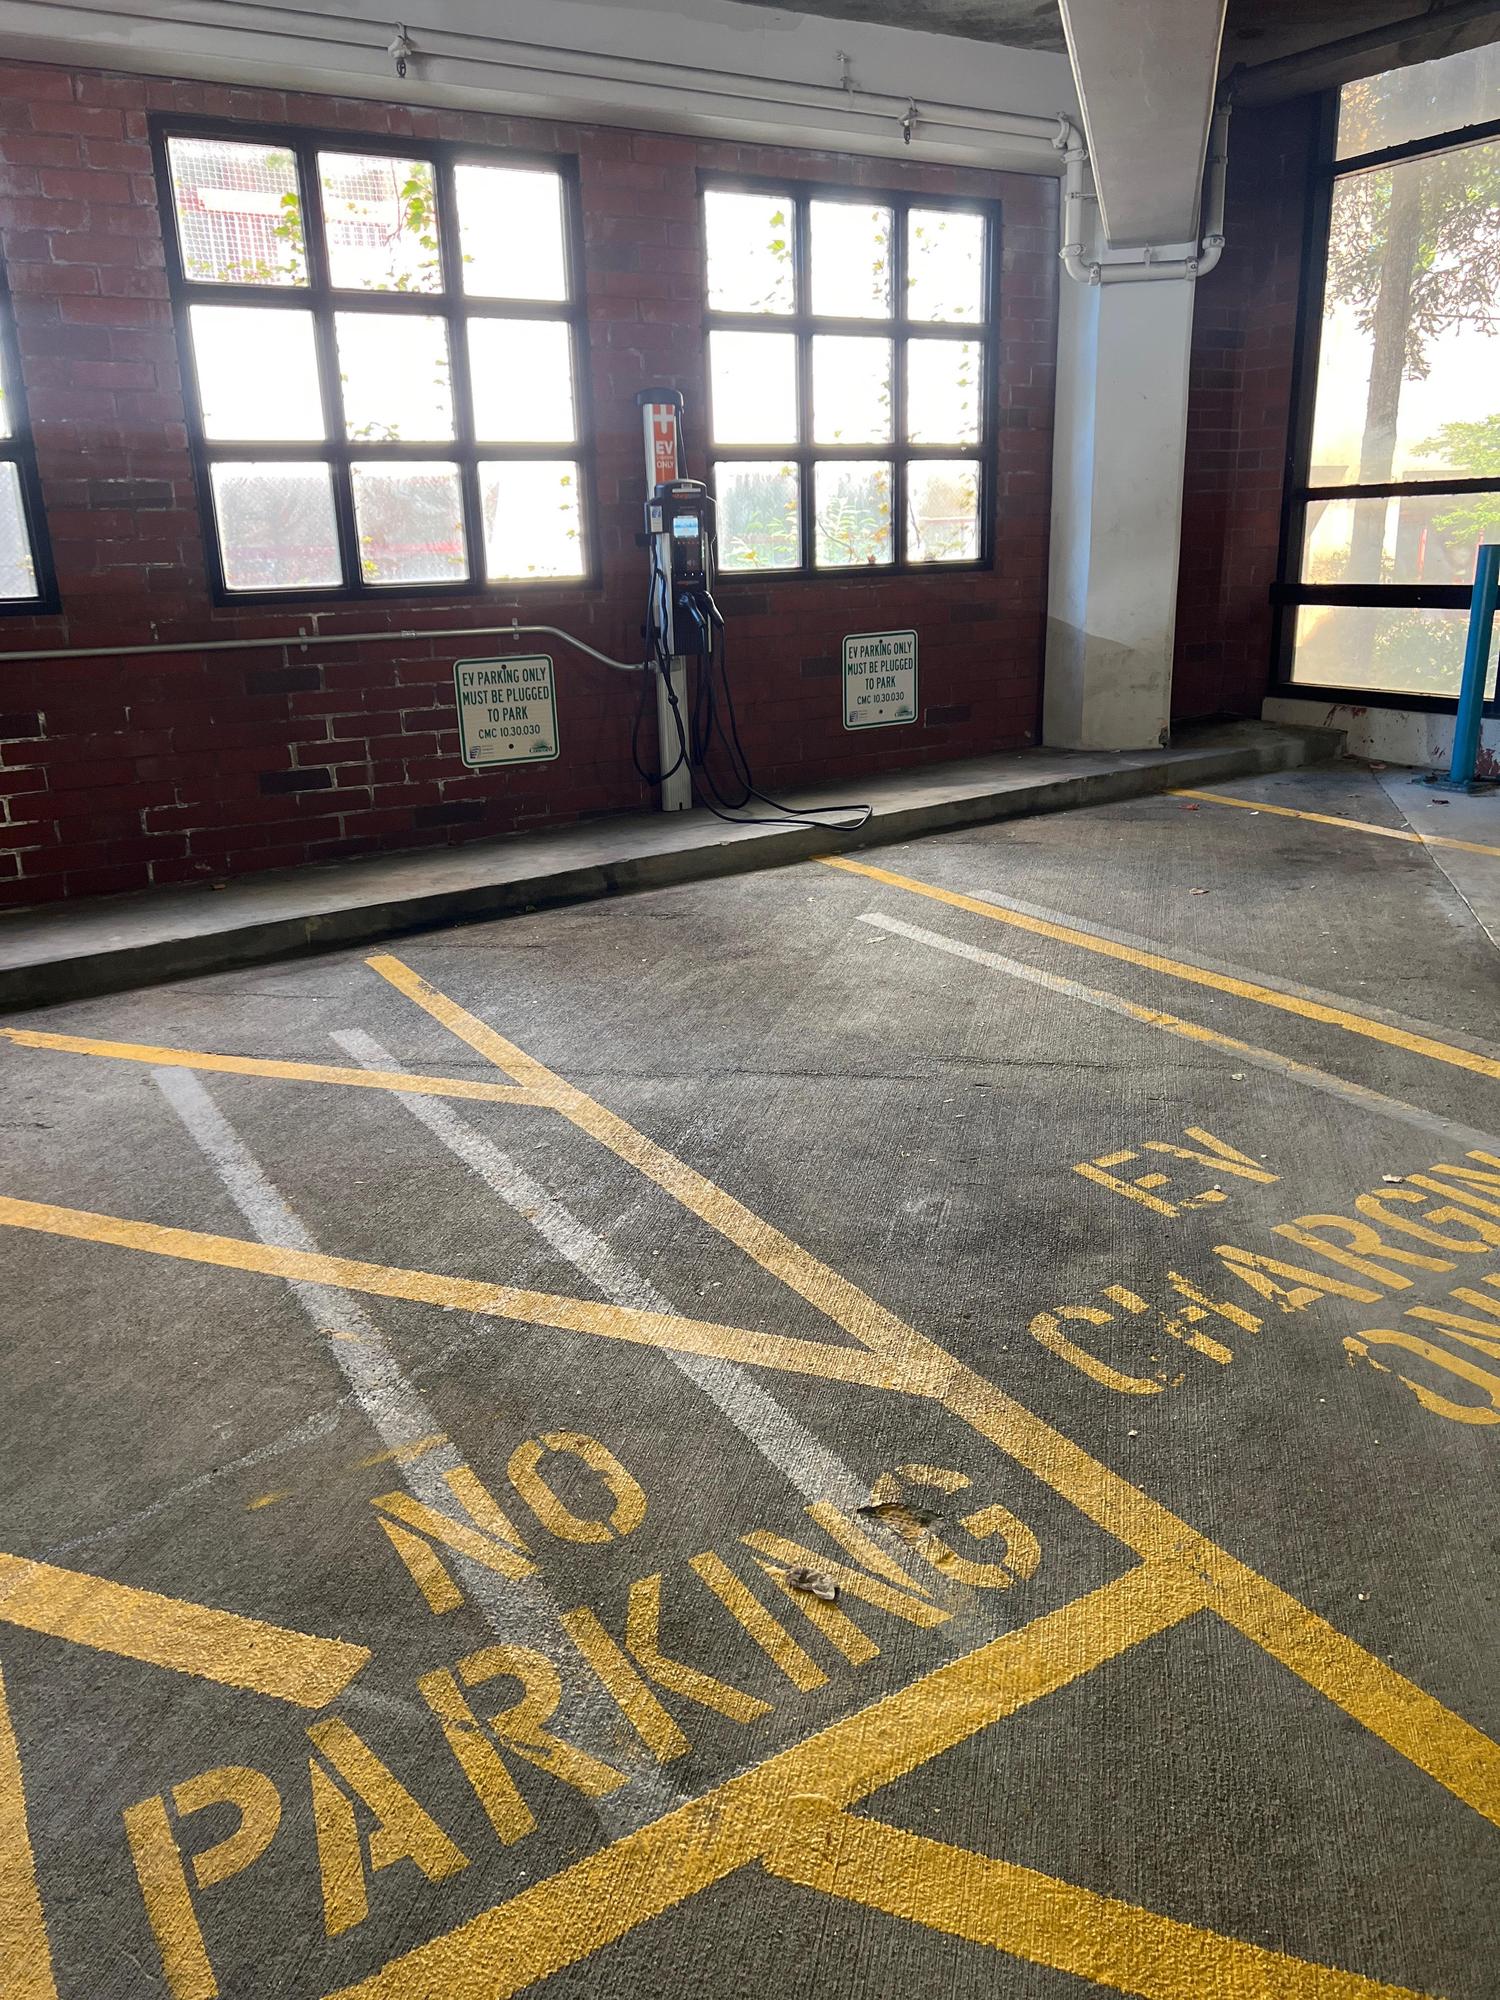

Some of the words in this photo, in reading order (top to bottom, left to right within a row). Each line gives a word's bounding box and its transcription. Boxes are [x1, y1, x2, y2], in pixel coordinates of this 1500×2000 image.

[655, 440, 673, 455] EV
[656, 460, 674, 469] ONLY
[848, 646, 858, 659] EV
[860, 642, 892, 658] PARKING
[893, 641, 912, 655] ONLY
[847, 662, 867, 676] MUST
[869, 660, 878, 673] BE
[880, 657, 913, 672] PLUGGED
[462, 672, 475, 686] EV
[477, 669, 520, 686] PARKING
[522, 667, 546, 682] ONLY
[865, 678, 874, 690] TO
[876, 675, 896, 689] PARK
[462, 690, 488, 706] MUST
[491, 689, 504, 704] BE
[506, 686, 550, 702] PLUGGED
[857, 695, 871, 705] CMC
[873, 691, 904, 703] 10.30.030
[487, 708, 500, 722] TO
[502, 706, 528, 721] PARK
[478, 728, 497, 739] CMC
[500, 724, 540, 737] 10.30.030
[1072, 1126, 1282, 1218] EV
[1342, 1272, 1500, 1425] ON
[370, 1430, 648, 1614] NO
[123, 1463, 1042, 2000] PARKING
